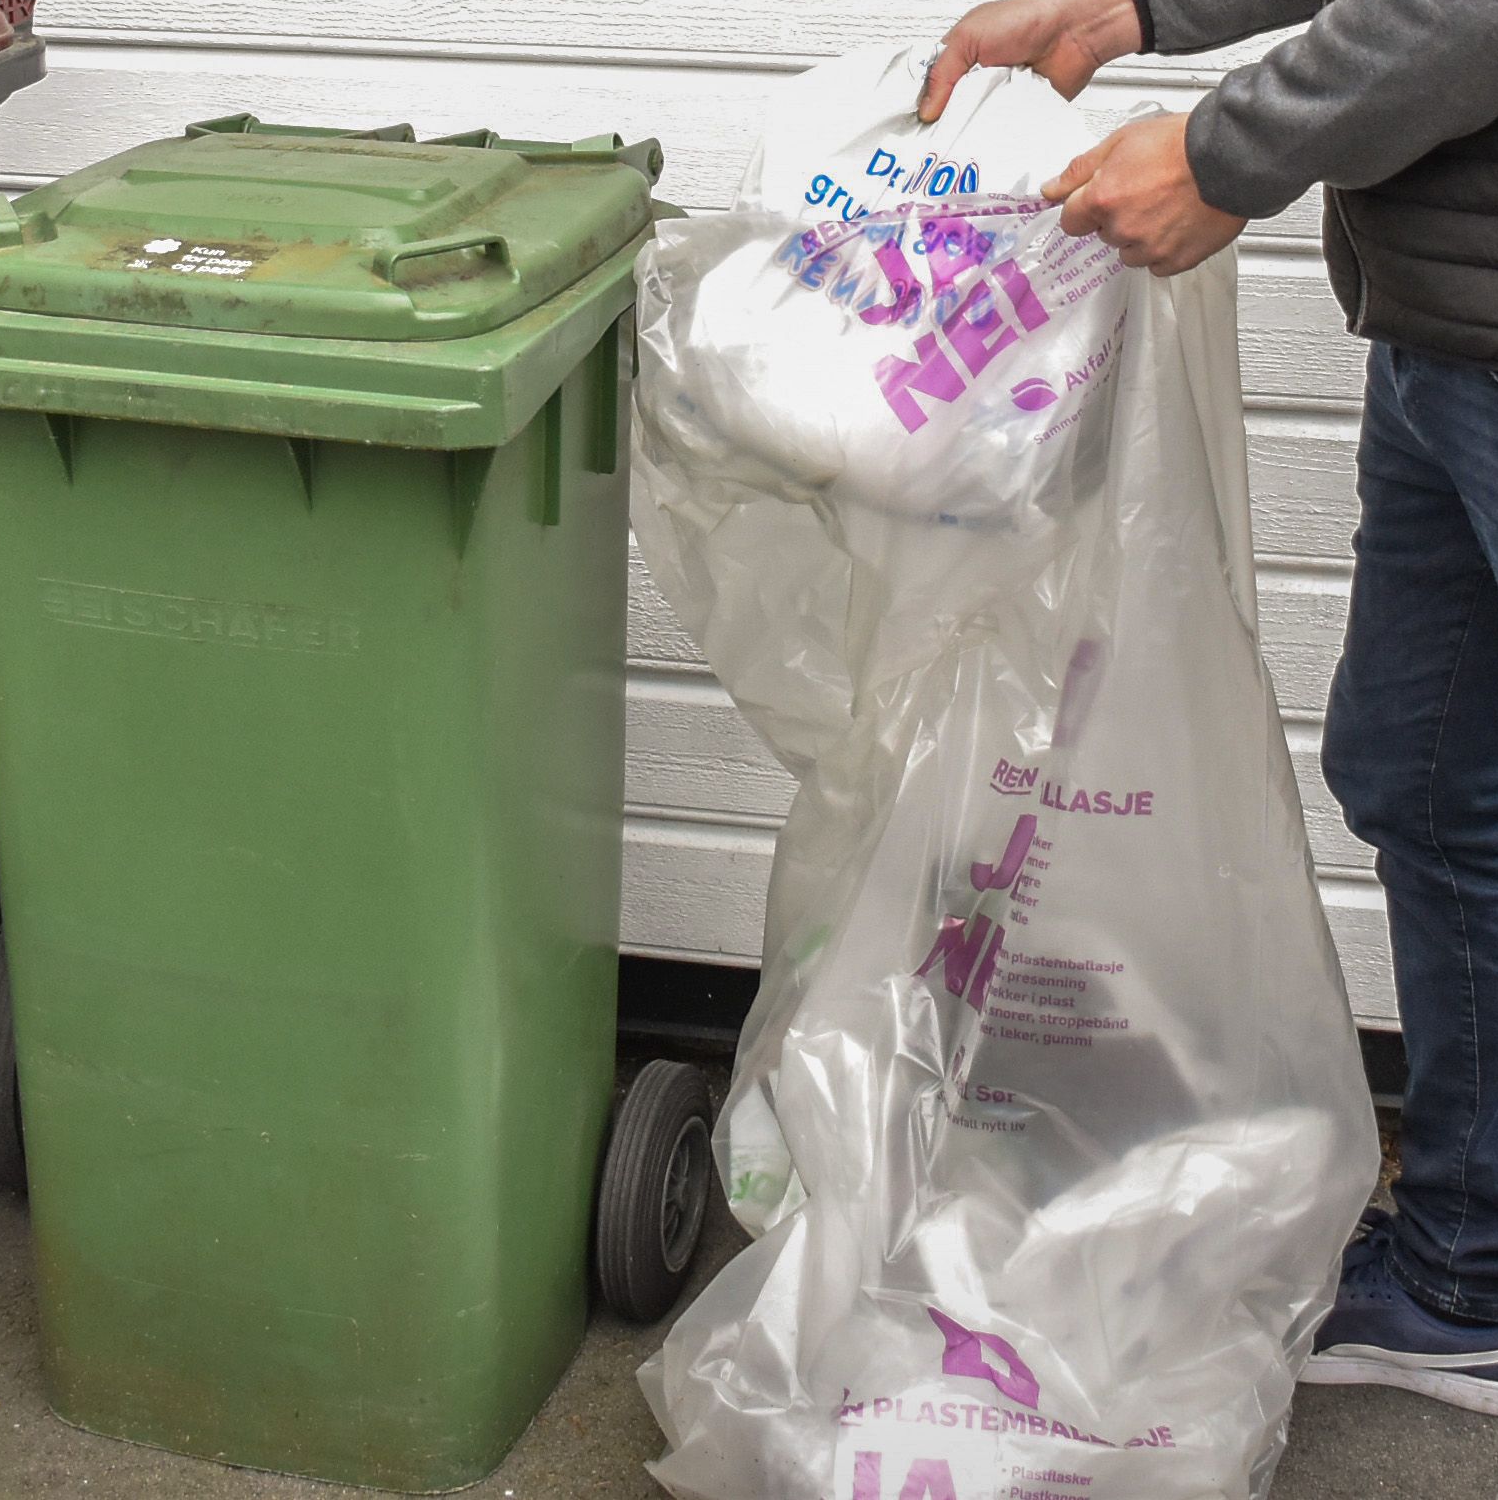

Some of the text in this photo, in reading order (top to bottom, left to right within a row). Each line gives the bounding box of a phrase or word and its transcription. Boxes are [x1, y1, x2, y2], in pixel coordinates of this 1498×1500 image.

[1056, 264, 1084, 286] Tau,
[1065, 272, 1108, 304] Bleier,
[874, 257, 1051, 435] NEI
[1065, 338, 1112, 392] Avfall
[992, 757, 1039, 788] REN
[1011, 951, 1125, 975] plastemballasje
[1007, 971, 1087, 992] presenning
[1038, 994, 1076, 1008] plast
[988, 1006, 1129, 1031] snorer, stroppebånd
[1000, 1026, 1039, 1044] leker,
[1043, 1032, 1093, 1047] gummi
[976, 1084, 1016, 1104] Sør
[982, 1120, 1007, 1133] nytt
[1010, 1120, 1026, 1132] liv
[1011, 1465, 1094, 1486] Plastflasker
